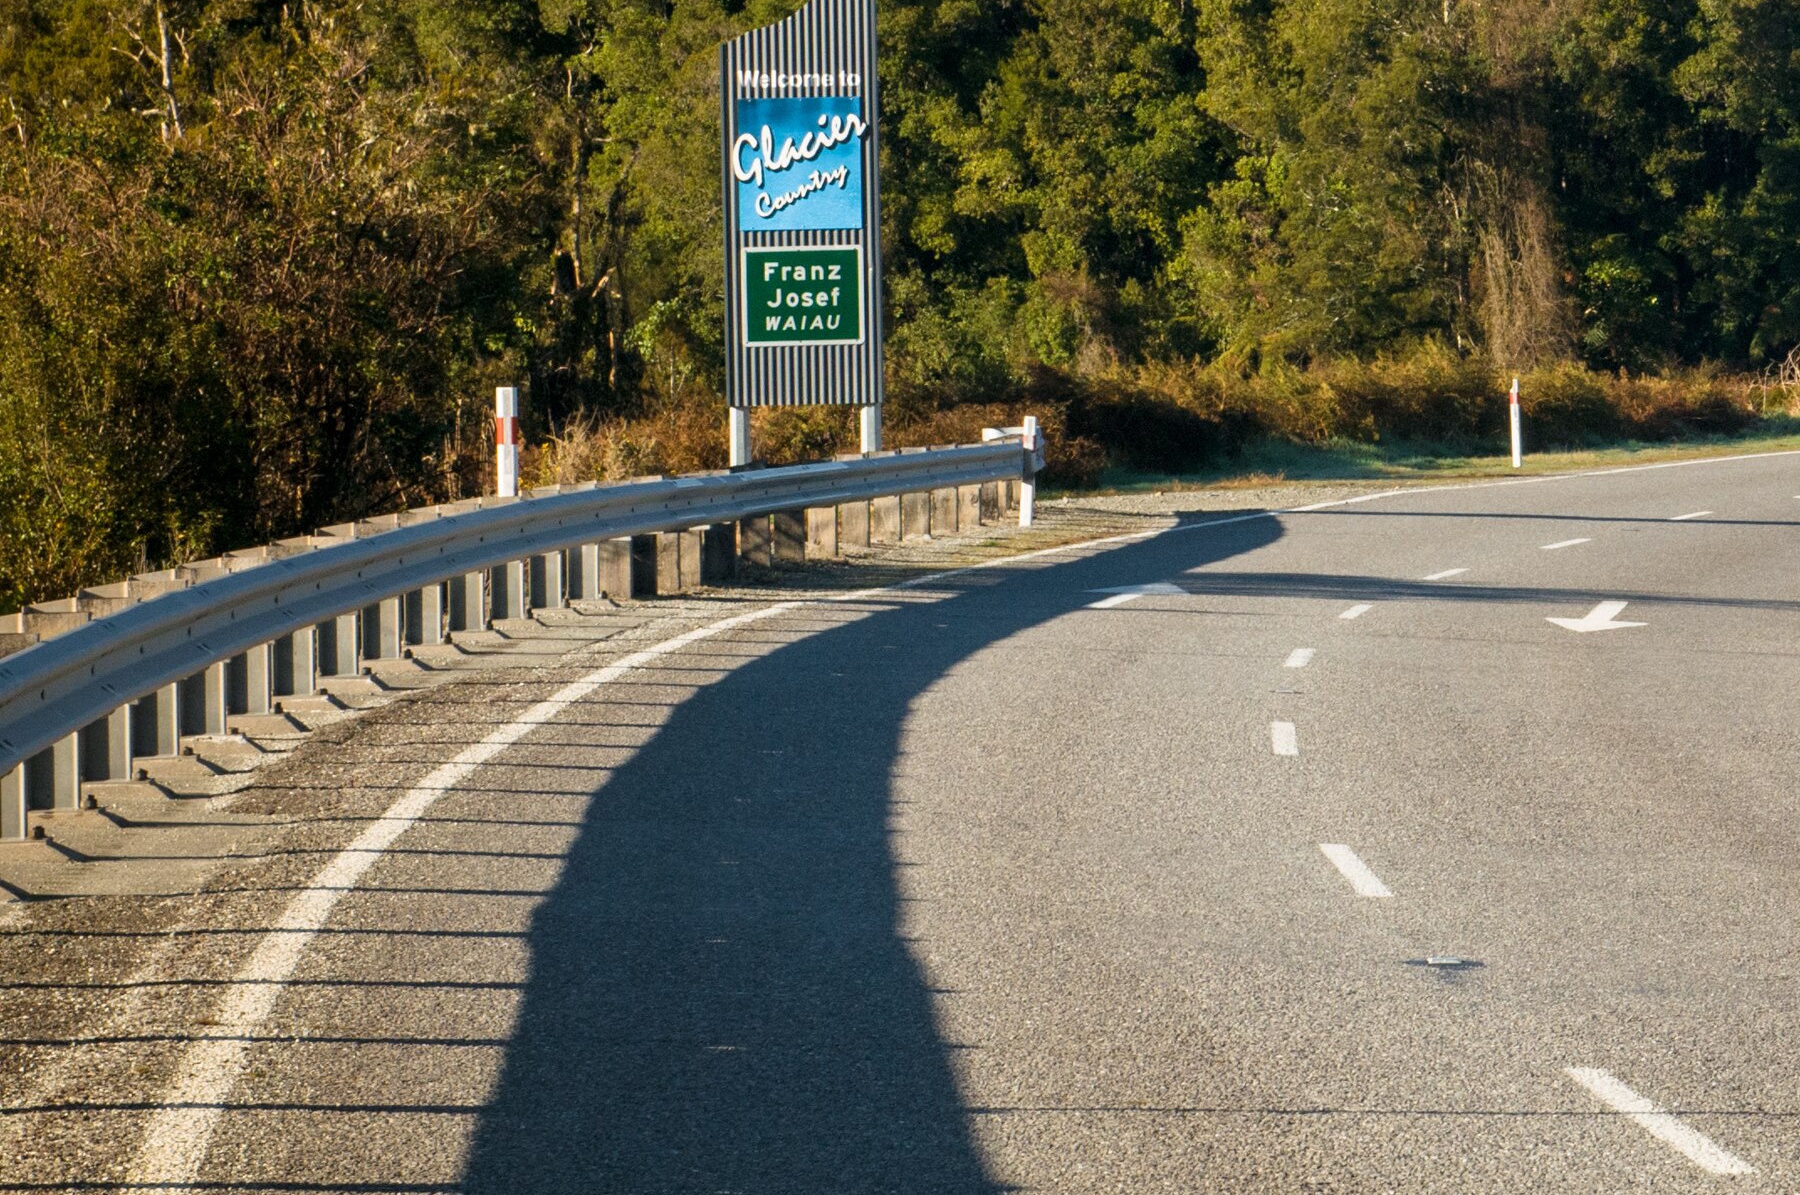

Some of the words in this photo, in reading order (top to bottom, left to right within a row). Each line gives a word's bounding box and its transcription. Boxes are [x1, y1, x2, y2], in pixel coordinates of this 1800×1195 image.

[737, 69, 834, 89] Welcome
[839, 70, 861, 88] to
[731, 113, 867, 188] Glacier
[754, 163, 848, 219] Country
[763, 262, 842, 282] Franz
[766, 288, 841, 308] Josef
[765, 314, 841, 332] WAIAU
